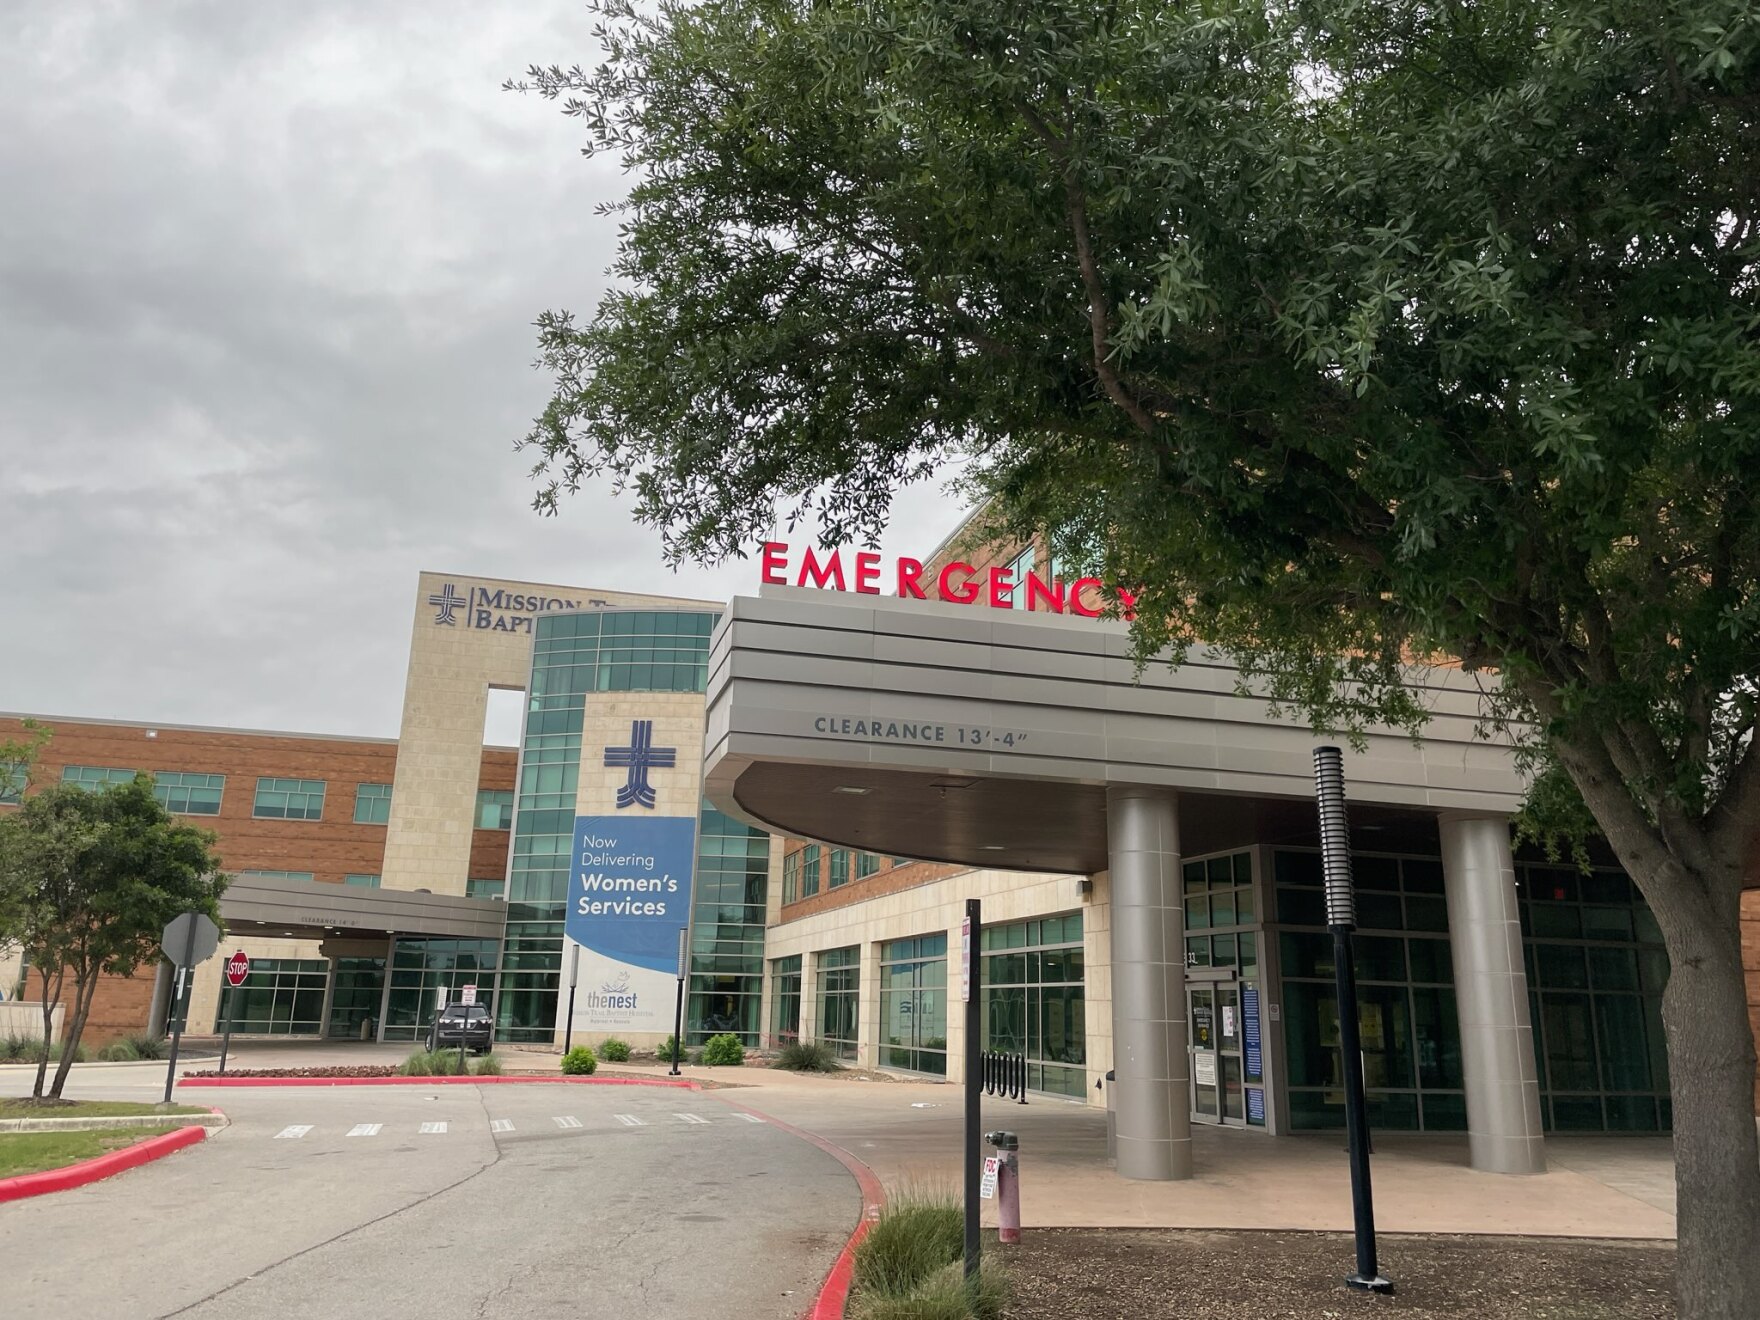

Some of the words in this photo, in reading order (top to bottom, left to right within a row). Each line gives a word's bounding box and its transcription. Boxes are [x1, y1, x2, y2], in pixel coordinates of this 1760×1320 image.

[814, 717, 944, 741] CLEARANCE
[583, 835, 617, 848] Now
[581, 852, 654, 871] Delivering
[581, 873, 678, 892] Women's
[577, 896, 666, 916] Services
[229, 962, 247, 975] STOP
[986, 1159, 997, 1174] FDC
